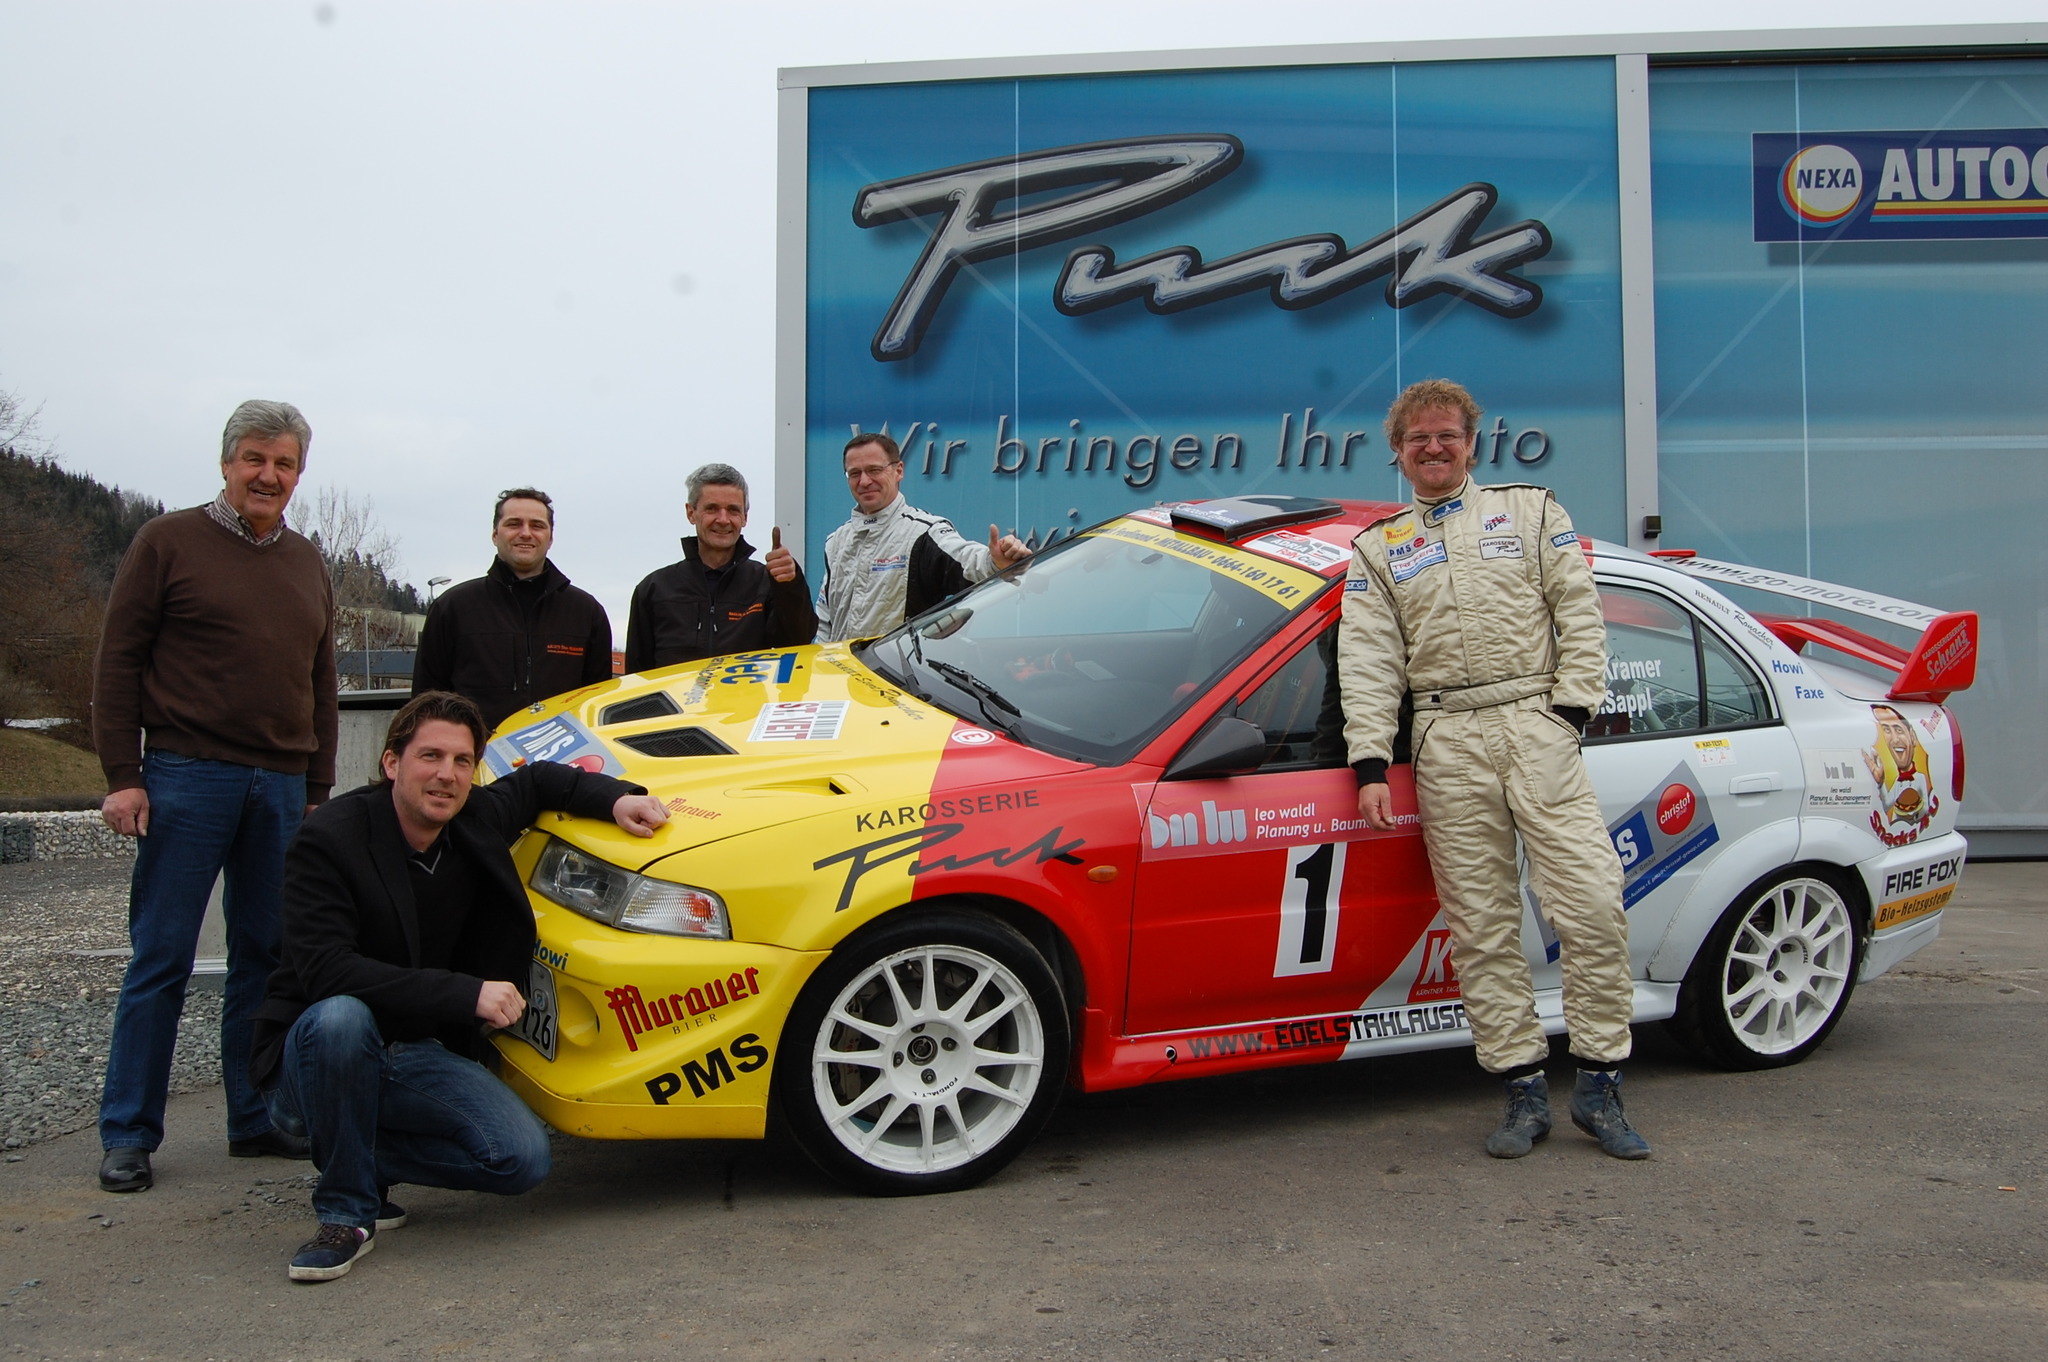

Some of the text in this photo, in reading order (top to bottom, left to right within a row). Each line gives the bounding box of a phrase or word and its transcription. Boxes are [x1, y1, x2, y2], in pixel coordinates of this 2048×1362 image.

[1797, 168, 1857, 190] NEXA
[992, 414, 1245, 488] bringen
[1277, 407, 1367, 468] Ihr
[1388, 416, 1551, 465] to
[1269, 539, 1309, 554] ADRIA
[1389, 544, 1412, 558] PMS
[1345, 581, 1367, 590] arco
[1695, 588, 1731, 616] RENAULT
[1604, 658, 1662, 681] Kramer
[1771, 659, 1804, 676] Howi
[1598, 688, 1652, 719] .Sappl
[1794, 685, 1825, 701] Faxe
[762, 716, 815, 740] VEIT
[516, 720, 576, 762] PMS
[856, 789, 1040, 833] KAROSSERIE
[1254, 802, 1315, 822] leo waldl
[1659, 791, 1692, 825] christof
[1255, 819, 1310, 840] Planung
[1313, 822, 1326, 834] u.
[1884, 856, 1961, 897] FIRE FOX
[1289, 842, 1339, 967] 1
[604, 966, 760, 1053] Murauer
[672, 1013, 719, 1036] BIER
[644, 1032, 770, 1106] PMS
[911, 1076, 959, 1099] FONDMTL
